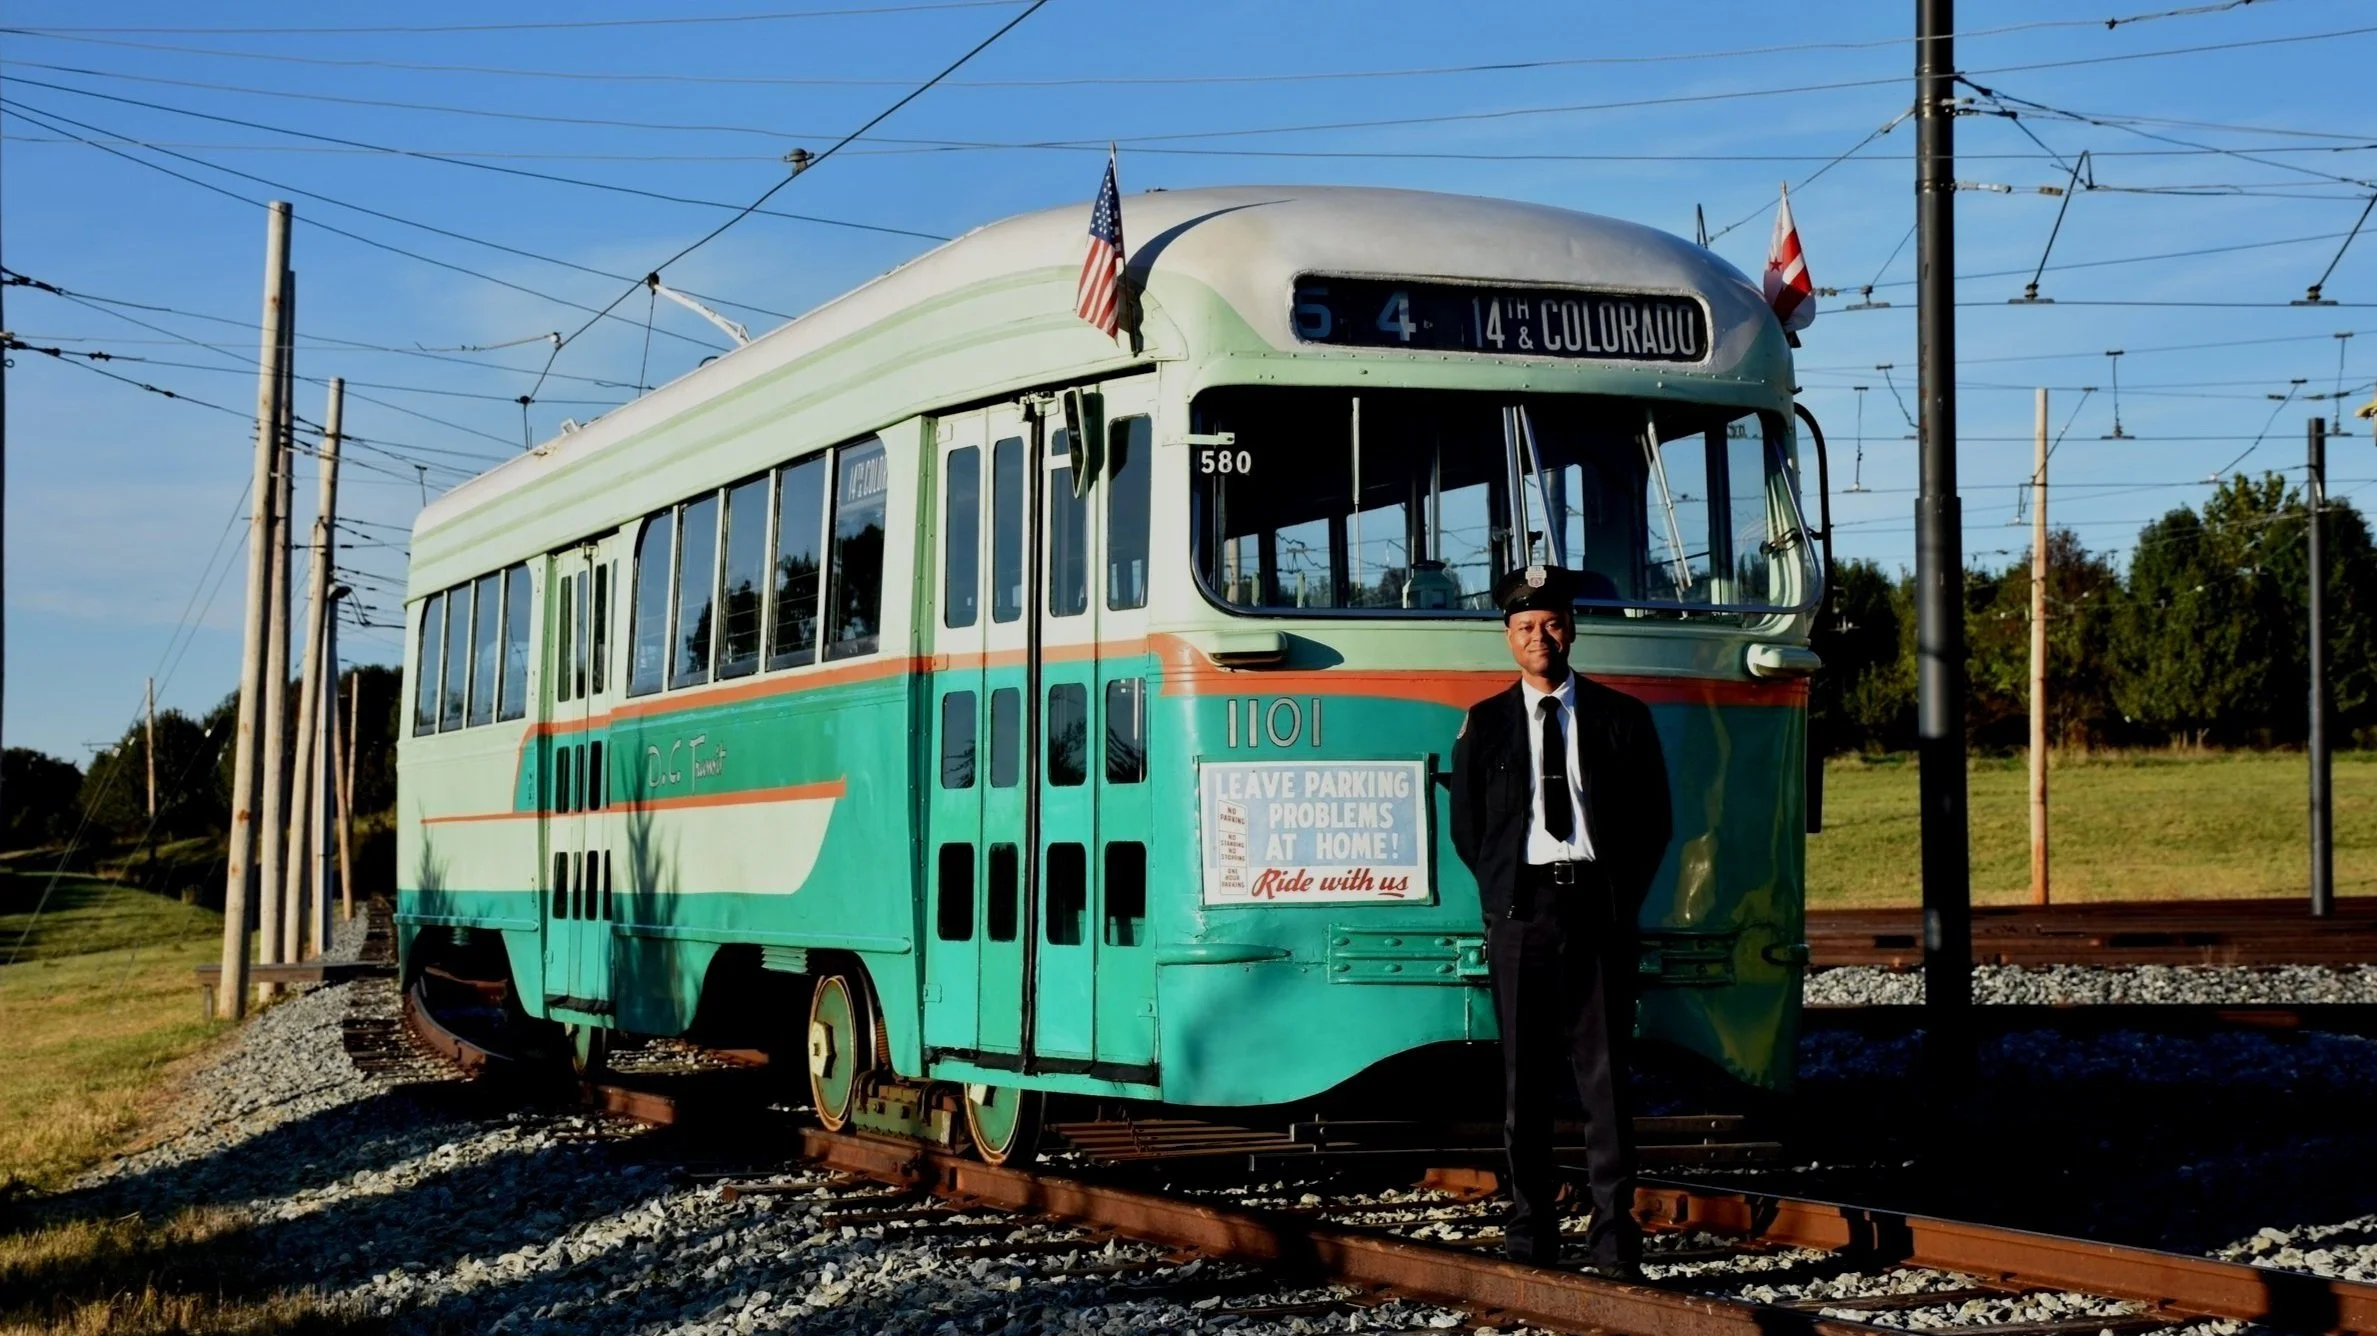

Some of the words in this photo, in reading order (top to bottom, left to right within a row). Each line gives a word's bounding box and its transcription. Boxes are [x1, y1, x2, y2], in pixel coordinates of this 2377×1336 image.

[1518, 326, 1533, 349] &
[1541, 299, 1696, 355] COLORADO
[1201, 450, 1251, 473] 580
[1228, 697, 1321, 748] 1101
[1215, 770, 1296, 800] LEAVE
[1305, 770, 1409, 799] PARKING
[1220, 813, 1245, 825] PARKING
[1269, 802, 1394, 829] PROBLEMS
[1265, 833, 1297, 861] AT
[1316, 832, 1399, 860] HOME!
[1251, 868, 1314, 900] Ride
[1319, 868, 1375, 892] with
[1379, 874, 1409, 896] us
